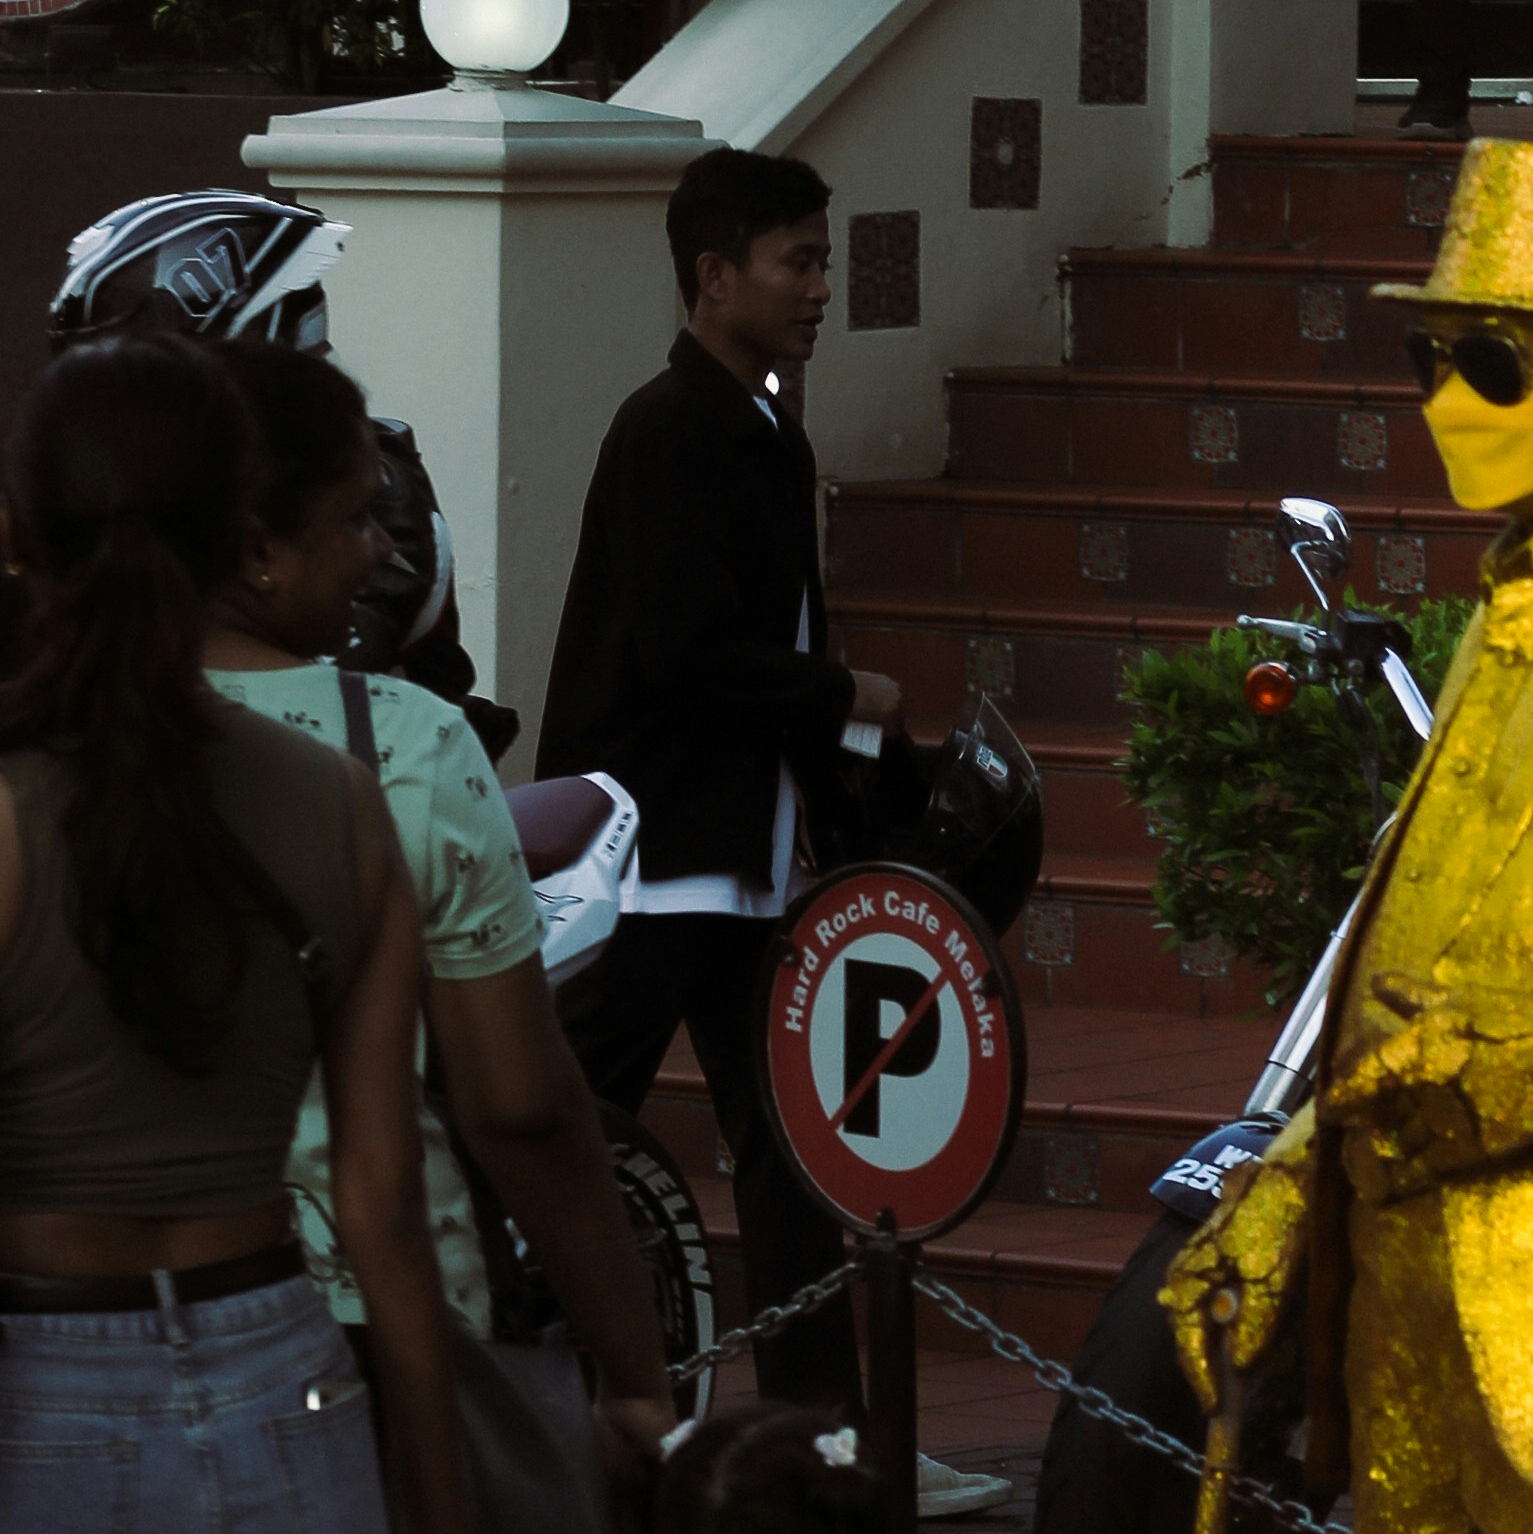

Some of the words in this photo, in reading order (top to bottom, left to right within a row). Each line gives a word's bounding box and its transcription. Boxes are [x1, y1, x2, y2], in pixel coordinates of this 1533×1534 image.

[785, 946, 820, 1033] Hard
[815, 893, 877, 948] Rock
[884, 890, 941, 935] Cafe
[842, 957, 943, 1140] P
[1213, 1144, 1265, 1170] W
